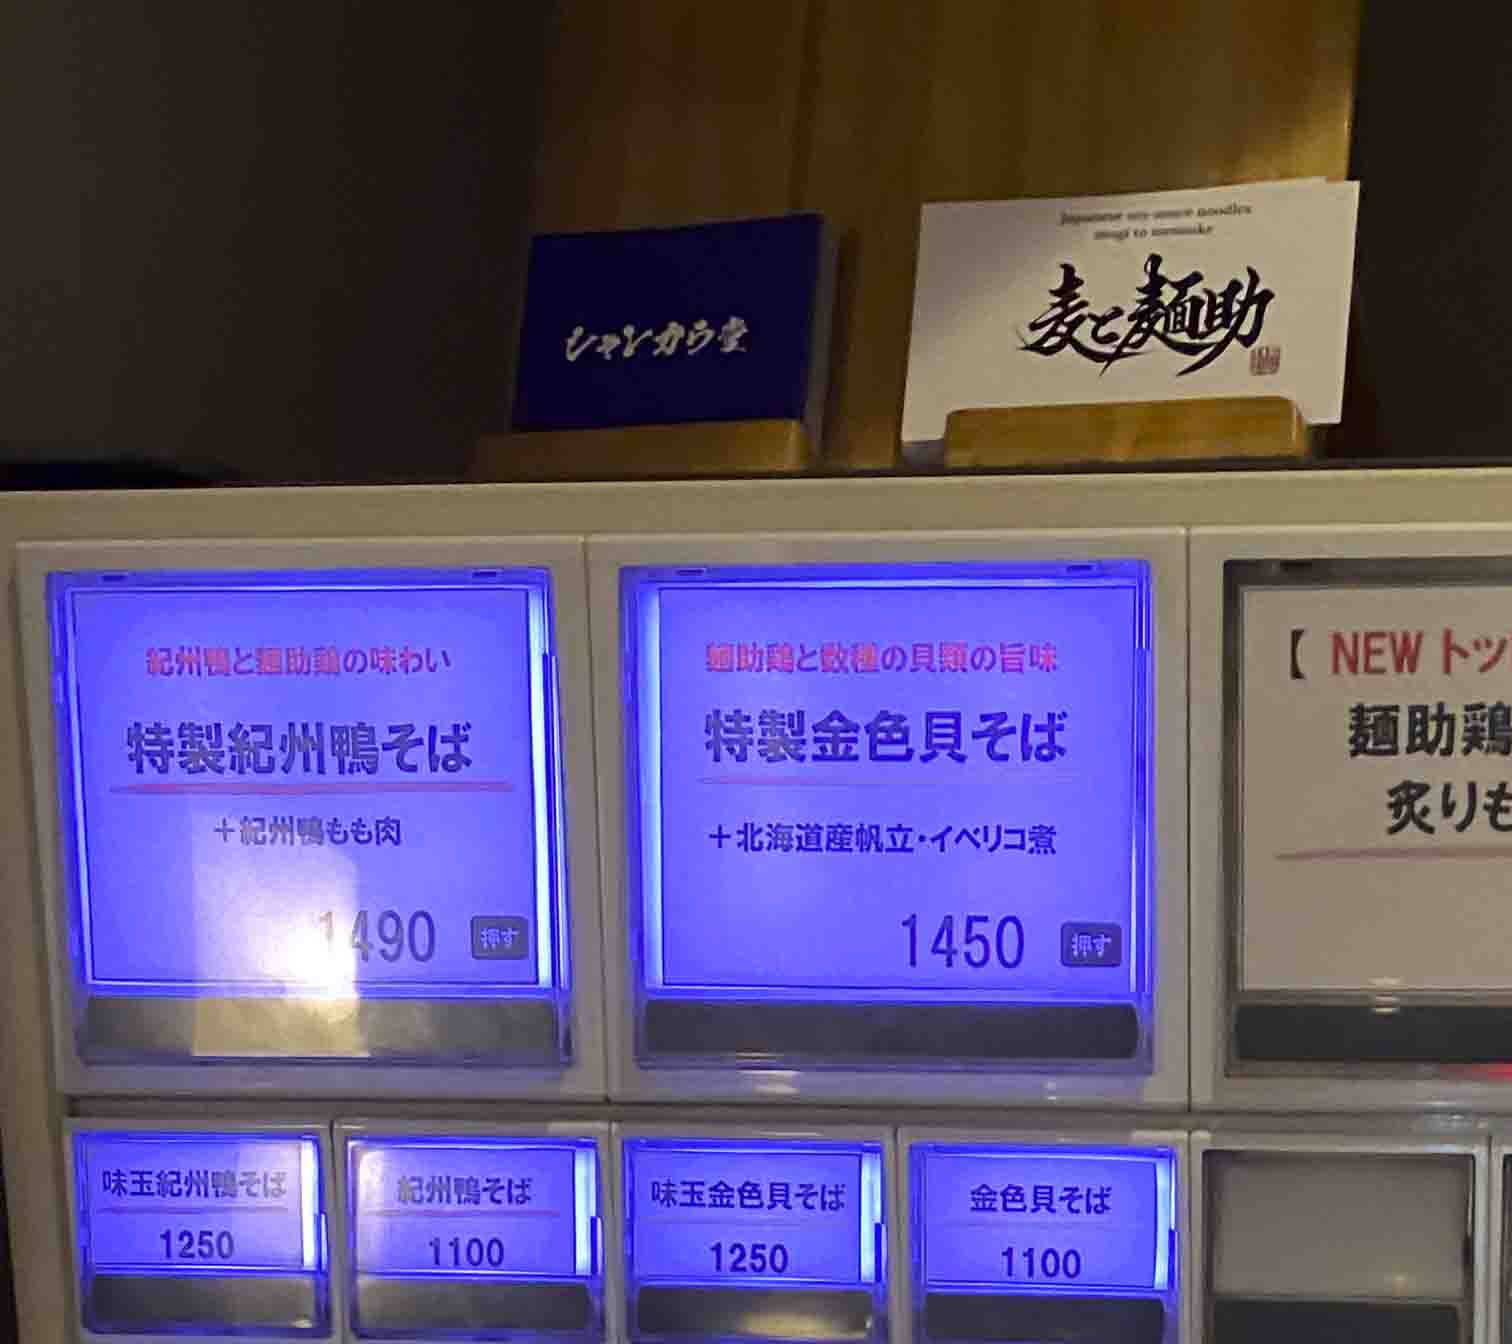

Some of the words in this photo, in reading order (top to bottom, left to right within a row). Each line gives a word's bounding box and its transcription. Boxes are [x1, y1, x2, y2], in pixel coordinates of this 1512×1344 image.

[1330, 630, 1423, 677] NEW
[126, 722, 473, 775] 特製紀州鴨そば
[704, 709, 1068, 765] 特製金色貝そば
[317, 910, 436, 964] 1490
[900, 914, 1025, 969] 1450
[1071, 932, 1112, 957] 押す
[101, 1168, 288, 1199] 味玉紀州鴨そば
[398, 1176, 534, 1207] 紀州鴨そば
[651, 1180, 847, 1212] 味玉金色貝そば
[970, 1184, 1113, 1216] 金色貝そば
[159, 1230, 235, 1260] 1250
[429, 1237, 505, 1267] 1100
[710, 1243, 790, 1274] 1250
[1001, 1247, 1083, 1279] 1100
